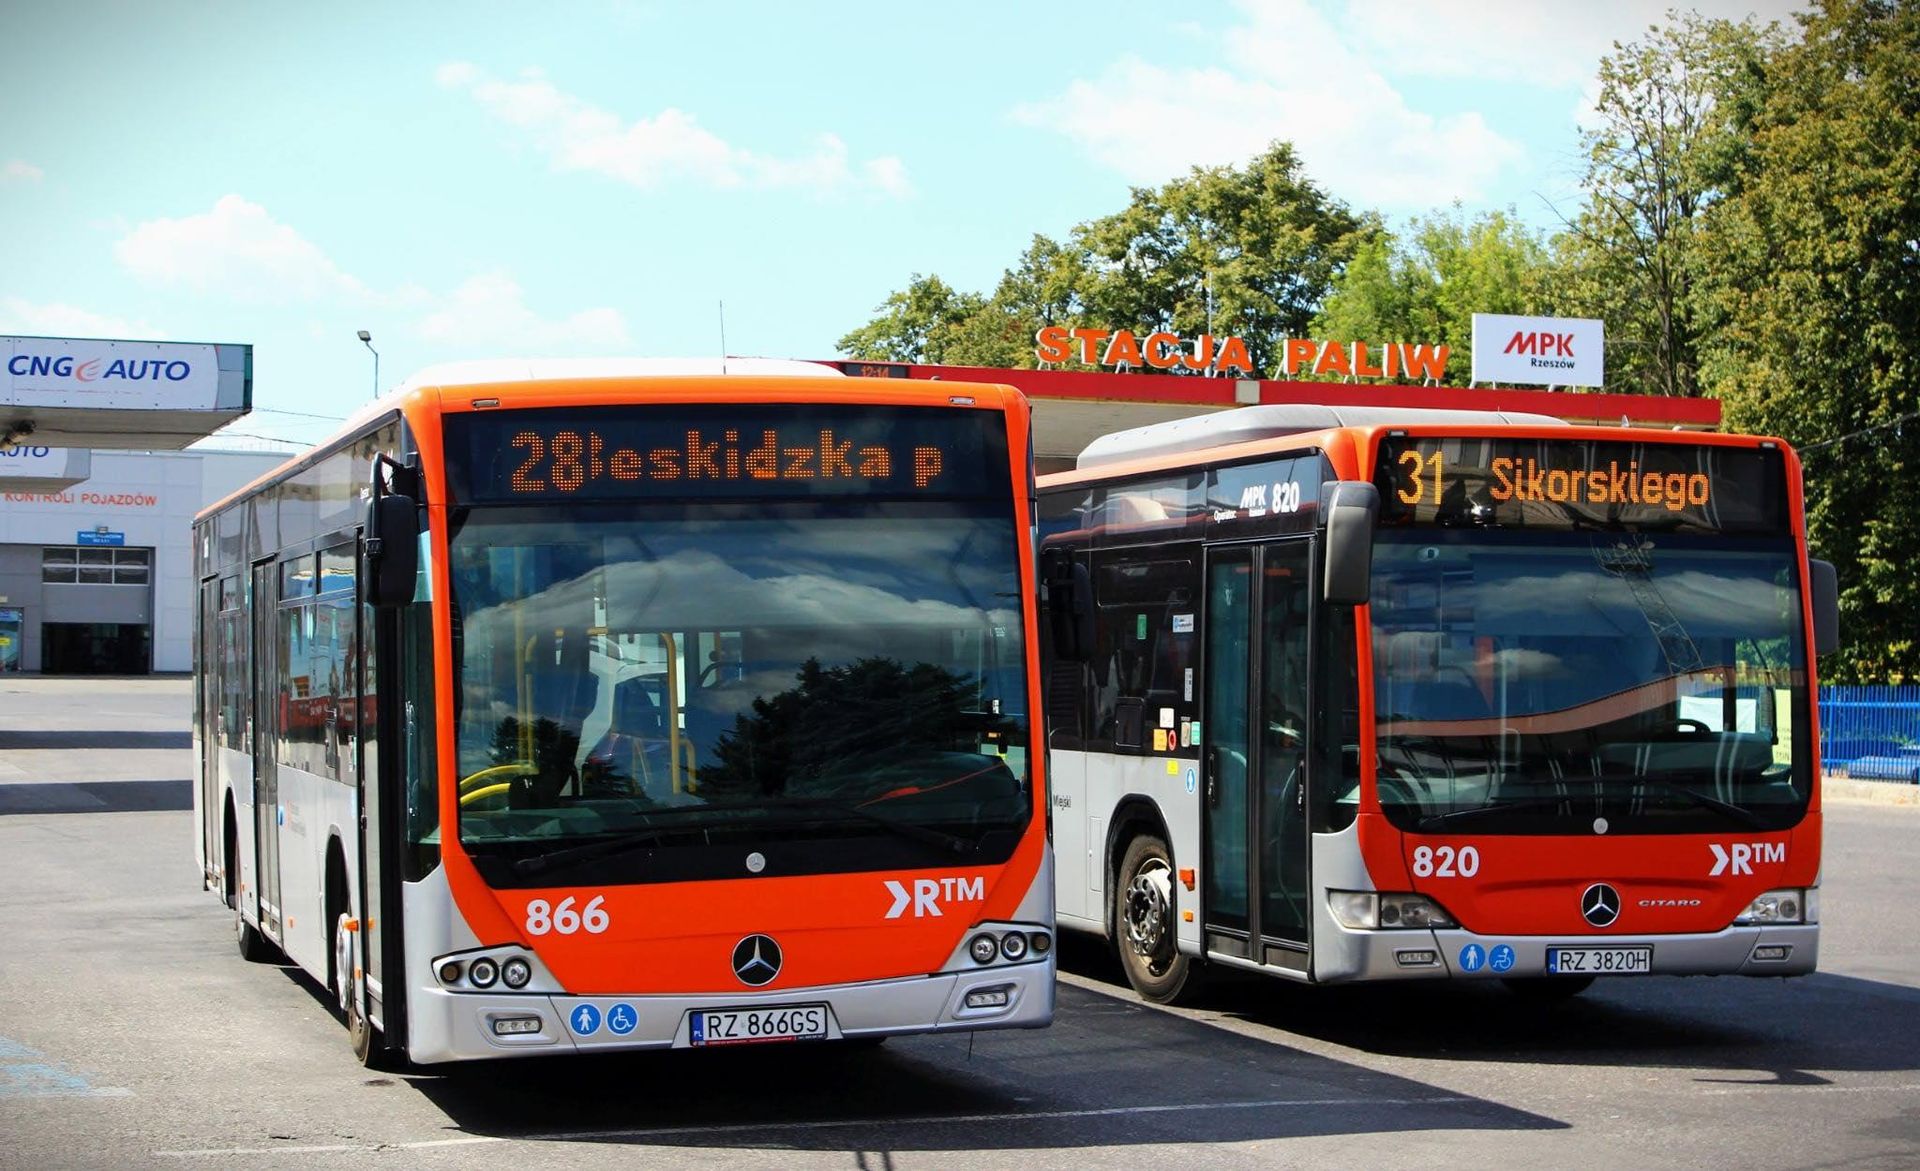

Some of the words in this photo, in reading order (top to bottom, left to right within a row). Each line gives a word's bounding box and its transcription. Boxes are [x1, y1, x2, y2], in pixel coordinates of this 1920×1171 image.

[1035, 326, 1254, 373] STACJA
[1284, 338, 1450, 380] PALIW
[1503, 330, 1575, 357] MPK
[8, 355, 74, 377] CNG
[102, 359, 191, 381] AUTO
[1530, 357, 1576, 369] Rzeszów
[511, 431, 583, 492] 28
[913, 446, 942, 488] p
[1240, 484, 1267, 509] MPK
[1272, 481, 1300, 514] 820
[1397, 450, 1443, 505] 31
[1490, 457, 1709, 512] Sikorskiego
[81, 492, 157, 507] POJAZDÓW
[1413, 845, 1480, 878] 820
[1731, 843, 1785, 876] RTM
[914, 876, 985, 918] RTM
[1638, 899, 1702, 908] CITARO
[526, 894, 610, 936] 866
[1560, 951, 1586, 971] RZ
[1593, 950, 1647, 971] 3820H
[708, 1014, 738, 1038] RZ
[748, 1010, 819, 1036] 866GS
